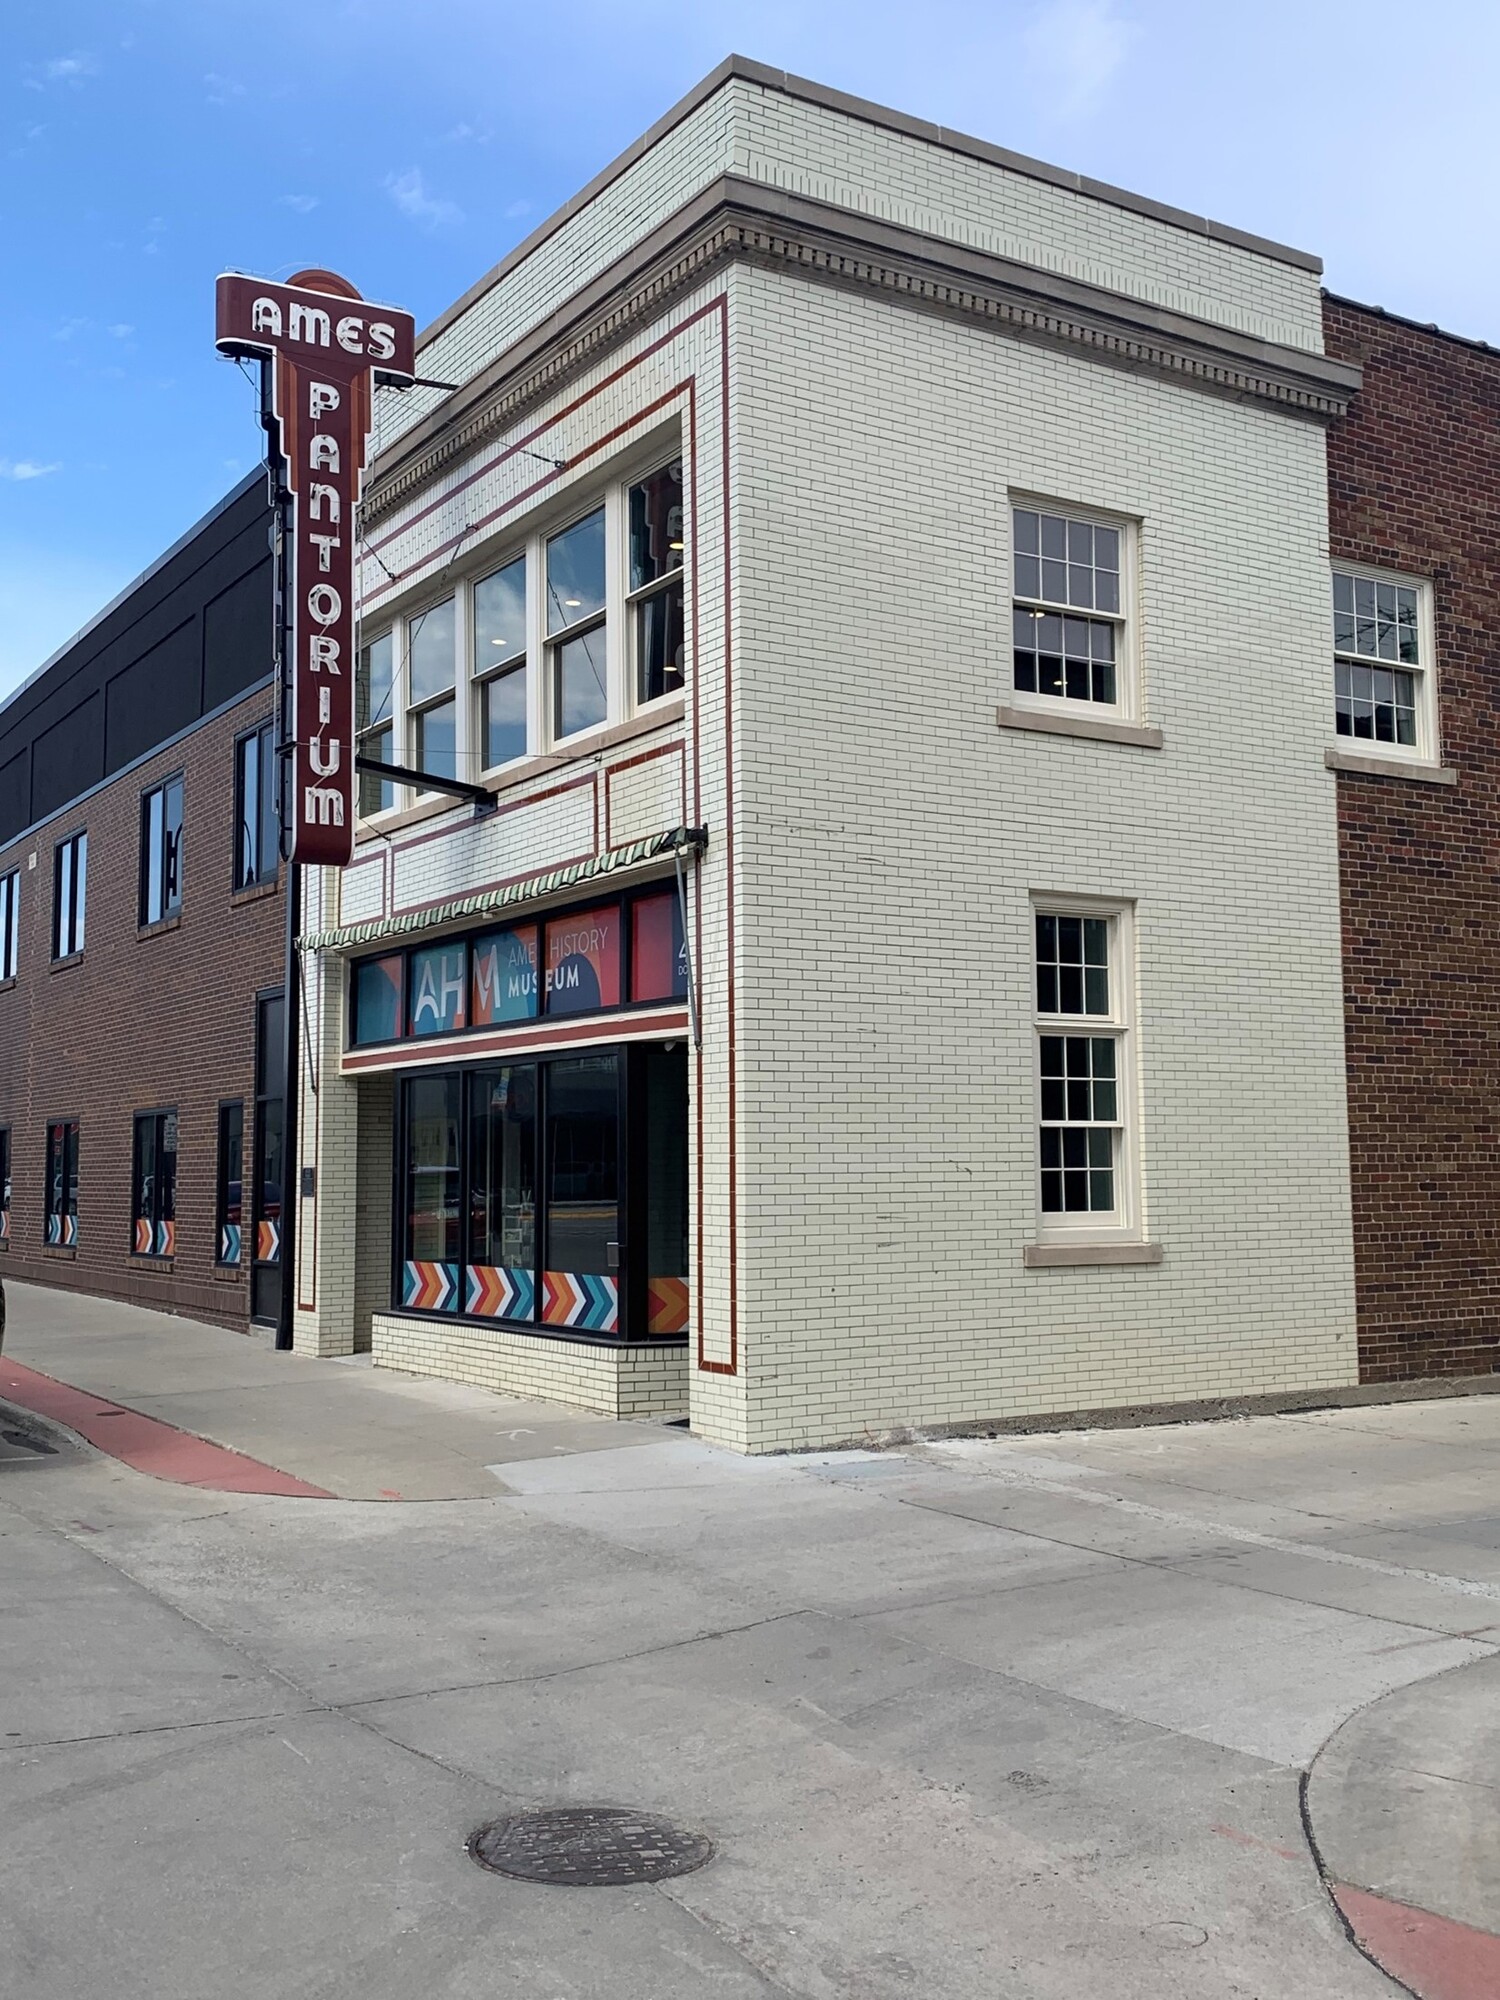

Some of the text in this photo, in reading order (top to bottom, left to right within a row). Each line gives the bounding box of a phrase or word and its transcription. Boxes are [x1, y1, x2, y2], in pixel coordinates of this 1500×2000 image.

[252, 297, 395, 360] AMES
[305, 382, 344, 826] PANTORIUM
[508, 926, 608, 968] AME HISTORY
[508, 964, 579, 998] MUSEUM
